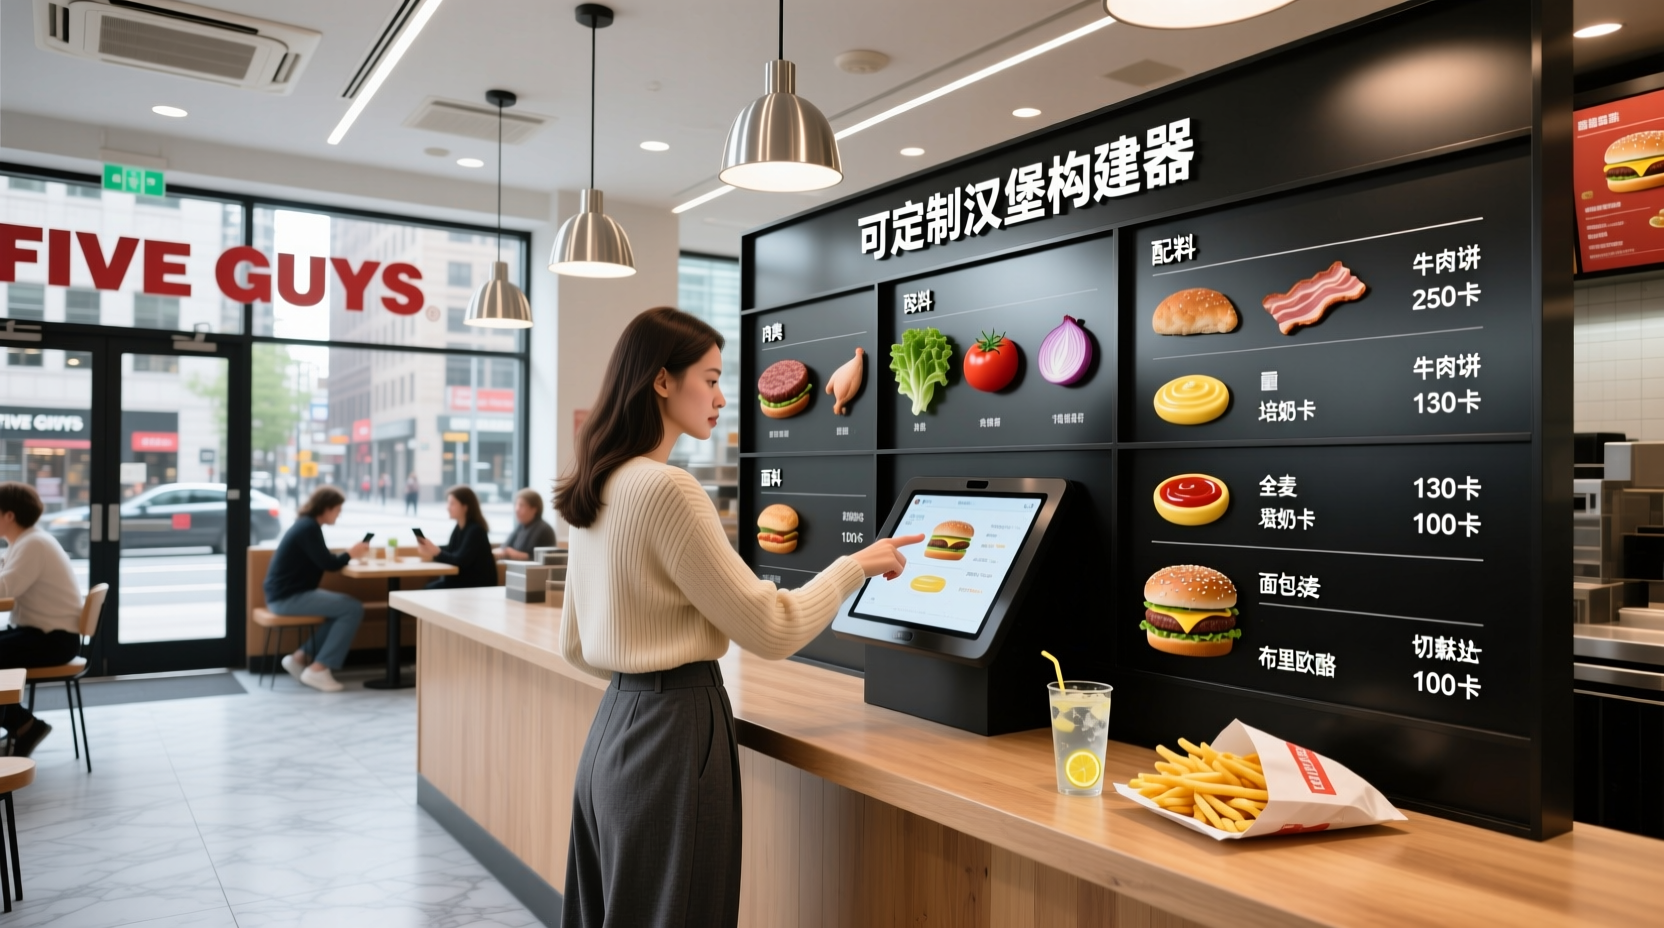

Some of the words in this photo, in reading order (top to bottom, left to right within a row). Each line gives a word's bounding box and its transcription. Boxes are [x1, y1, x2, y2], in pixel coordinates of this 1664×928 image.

[858, 117, 1194, 260] 可定制汉堡构建器
[1151, 234, 1196, 266] 配料
[1412, 244, 1482, 276] 牛肉饼
[0, 223, 192, 297] FIVE
[215, 245, 425, 316] GUYS
[1412, 281, 1482, 311] 250卡
[1412, 352, 1482, 381] 牛肉饼
[1413, 388, 1482, 414] 130卡
[1258, 473, 1298, 498] 全麦
[1413, 475, 1482, 501] 130卡
[1413, 512, 1482, 538] 100卡
[1413, 670, 1482, 700] 100卡
